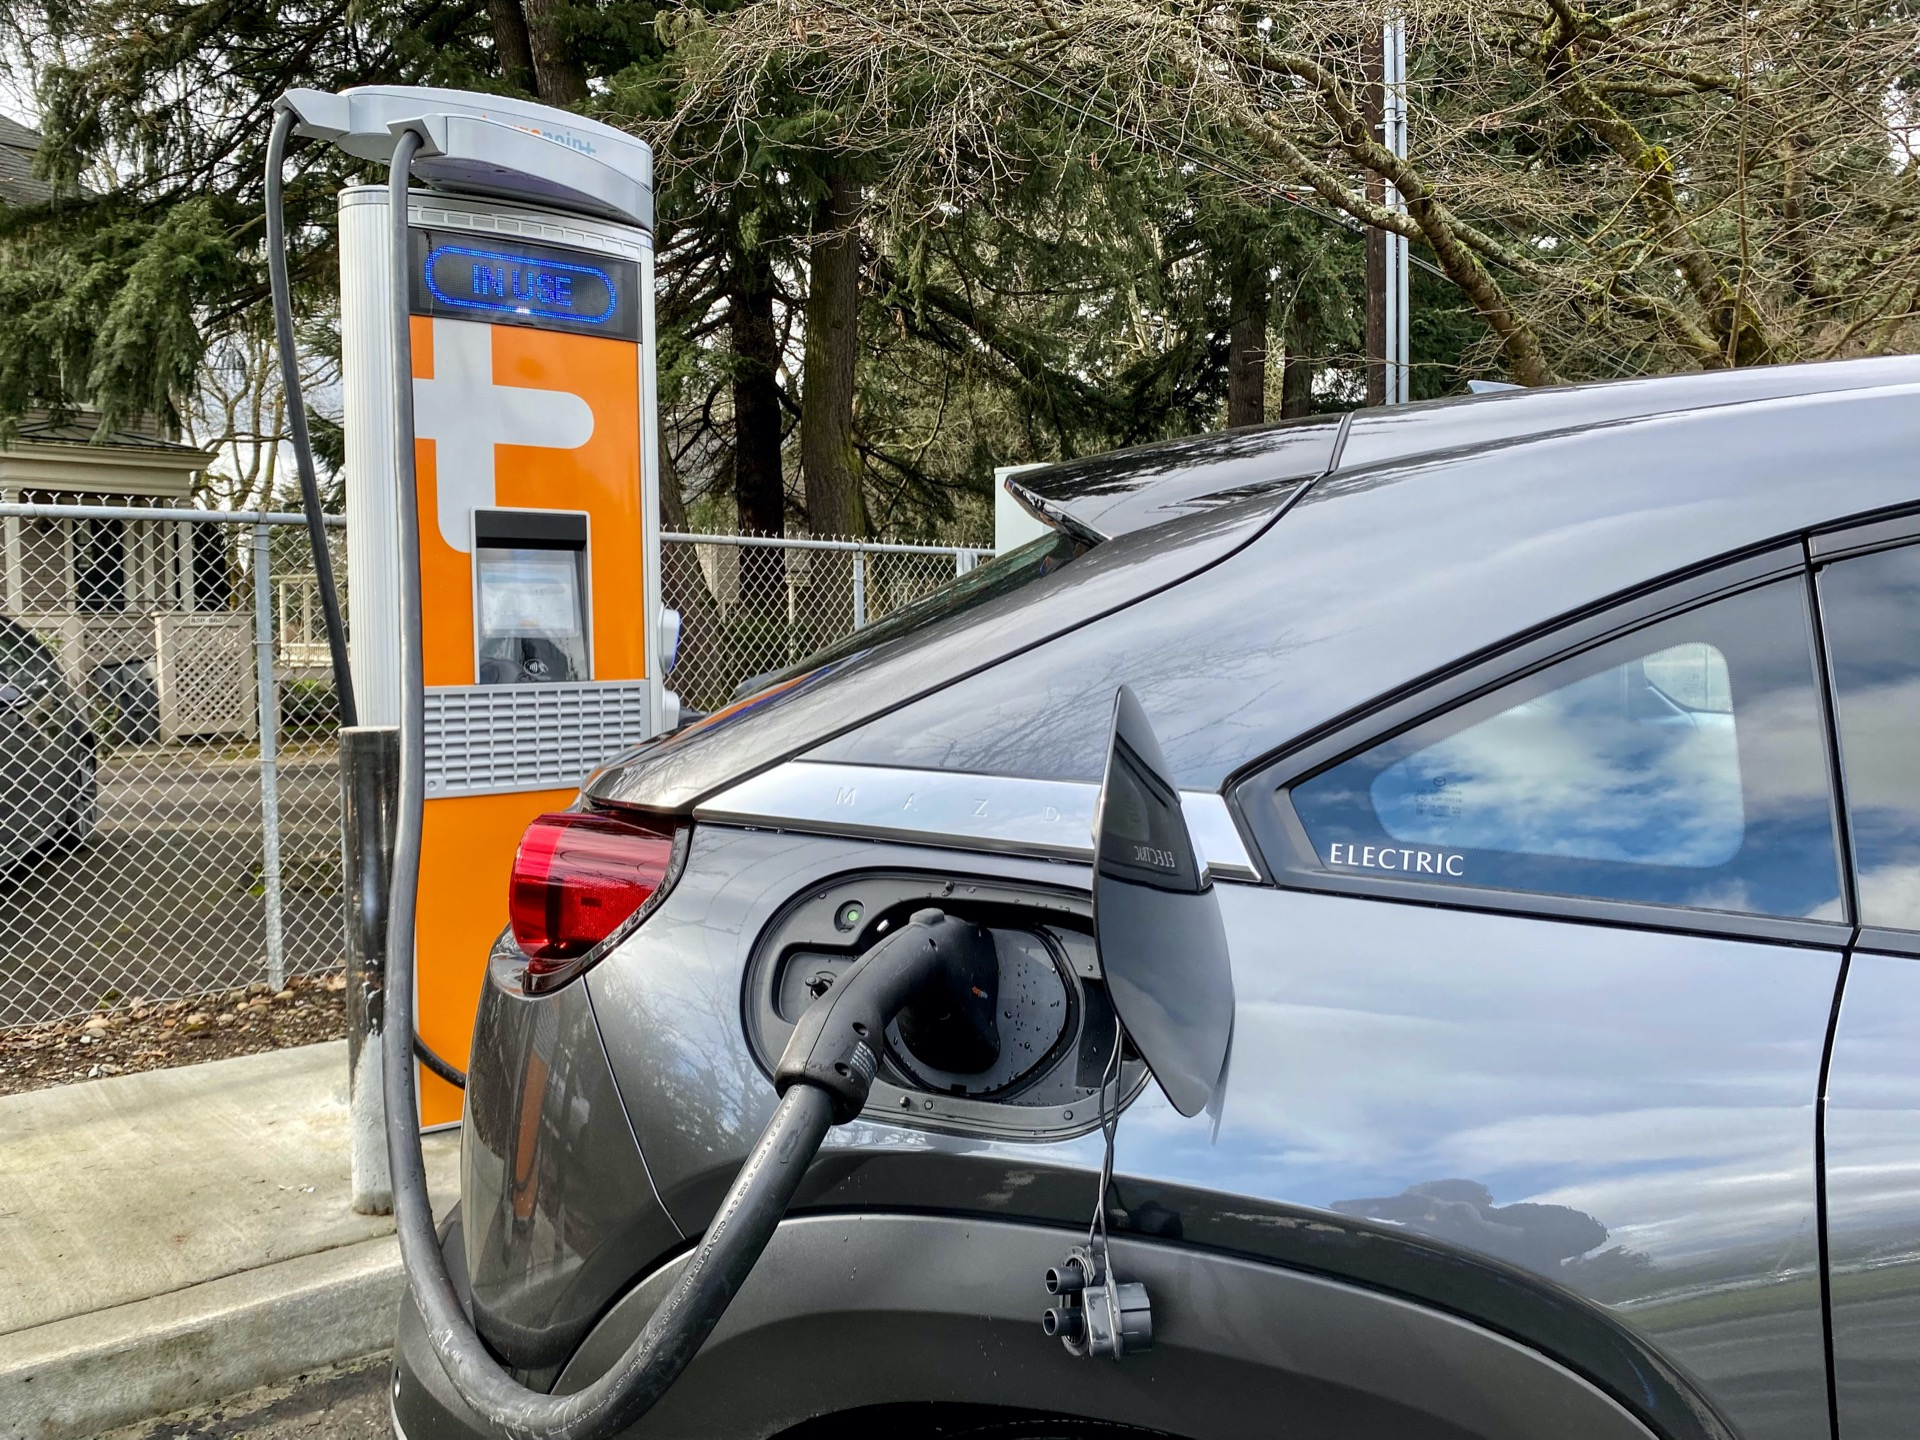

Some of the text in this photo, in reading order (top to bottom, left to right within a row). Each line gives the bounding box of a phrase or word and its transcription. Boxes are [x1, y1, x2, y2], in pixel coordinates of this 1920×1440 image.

[473, 264, 572, 307] IN USE
[836, 787, 1061, 823] MAZD
[1330, 842, 1464, 877] ELECTRIC
